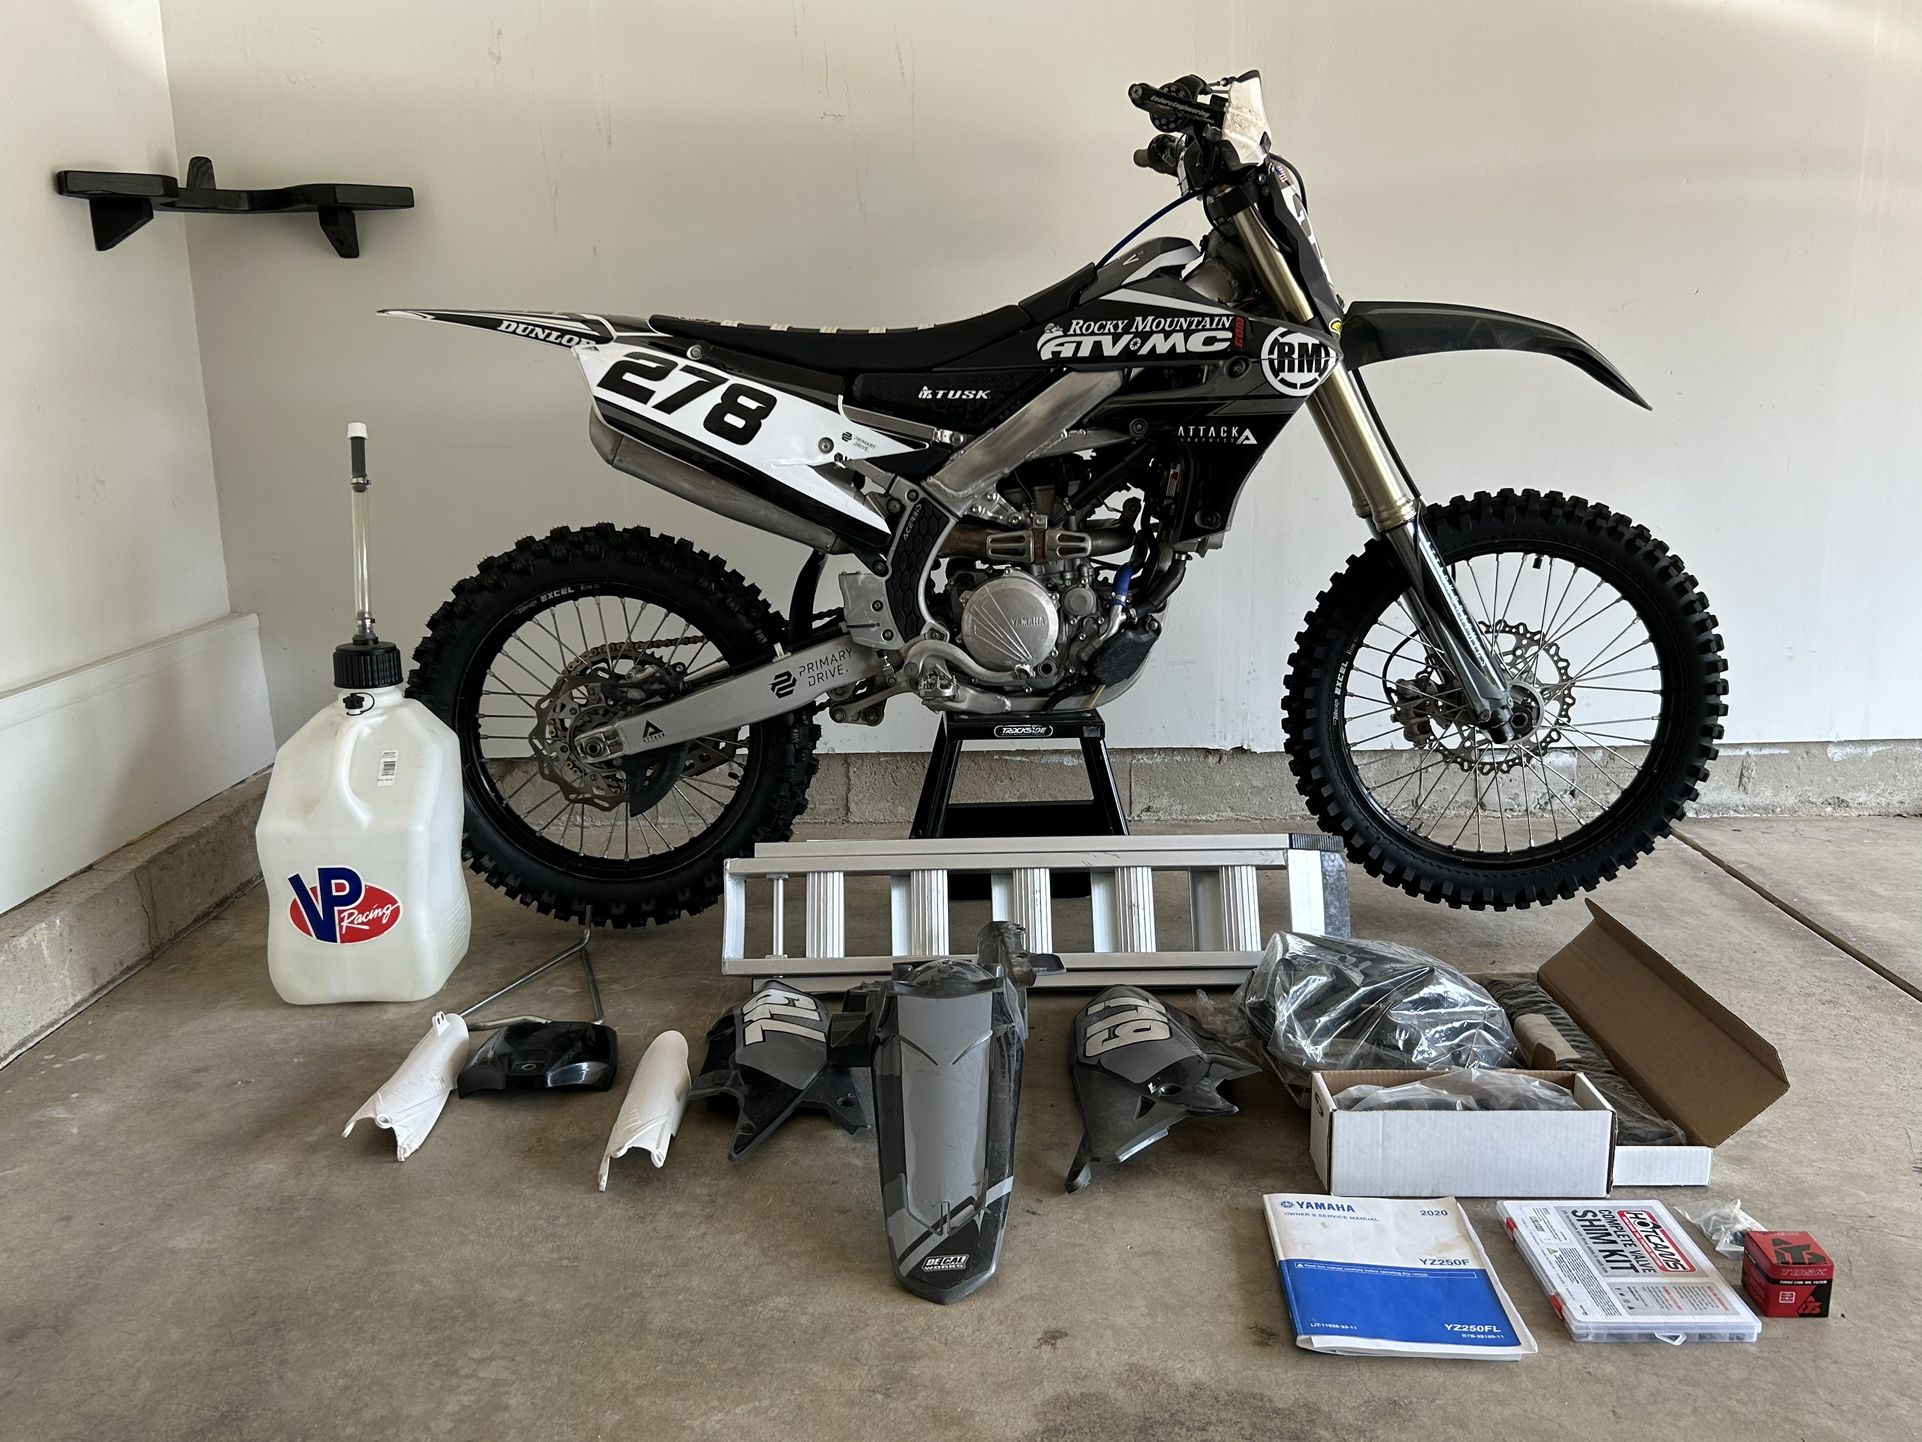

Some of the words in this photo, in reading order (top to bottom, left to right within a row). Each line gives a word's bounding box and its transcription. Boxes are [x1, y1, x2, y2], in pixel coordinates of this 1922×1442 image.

[1067, 319, 1129, 334] ROCKY
[1130, 316, 1235, 333] MOUNTAIN
[1278, 341, 1321, 374] RM
[597, 351, 778, 446] 278
[935, 389, 991, 400] TUSK
[1178, 425, 1239, 438] ATTACK
[540, 587, 575, 602] EXCEL
[1010, 616, 1046, 627] YAMAHA
[798, 647, 853, 677] PRIMARY
[1334, 661, 1348, 695] EXCEL
[288, 866, 363, 944] VP
[341, 902, 400, 934] Racing
[1296, 1201, 1356, 1213] YAMAHA
[1420, 1209, 1449, 1217] 2020
[1571, 1209, 1620, 1245] SHIM
[1598, 1249, 1641, 1273] KIT
[1599, 1209, 1638, 1248] COMPLETE
[1629, 1250, 1658, 1273] VALVE
[1419, 1258, 1470, 1266] YZ250F
[1780, 1268, 1828, 1276] TUSK
[1444, 1323, 1502, 1333] YZ250FL
